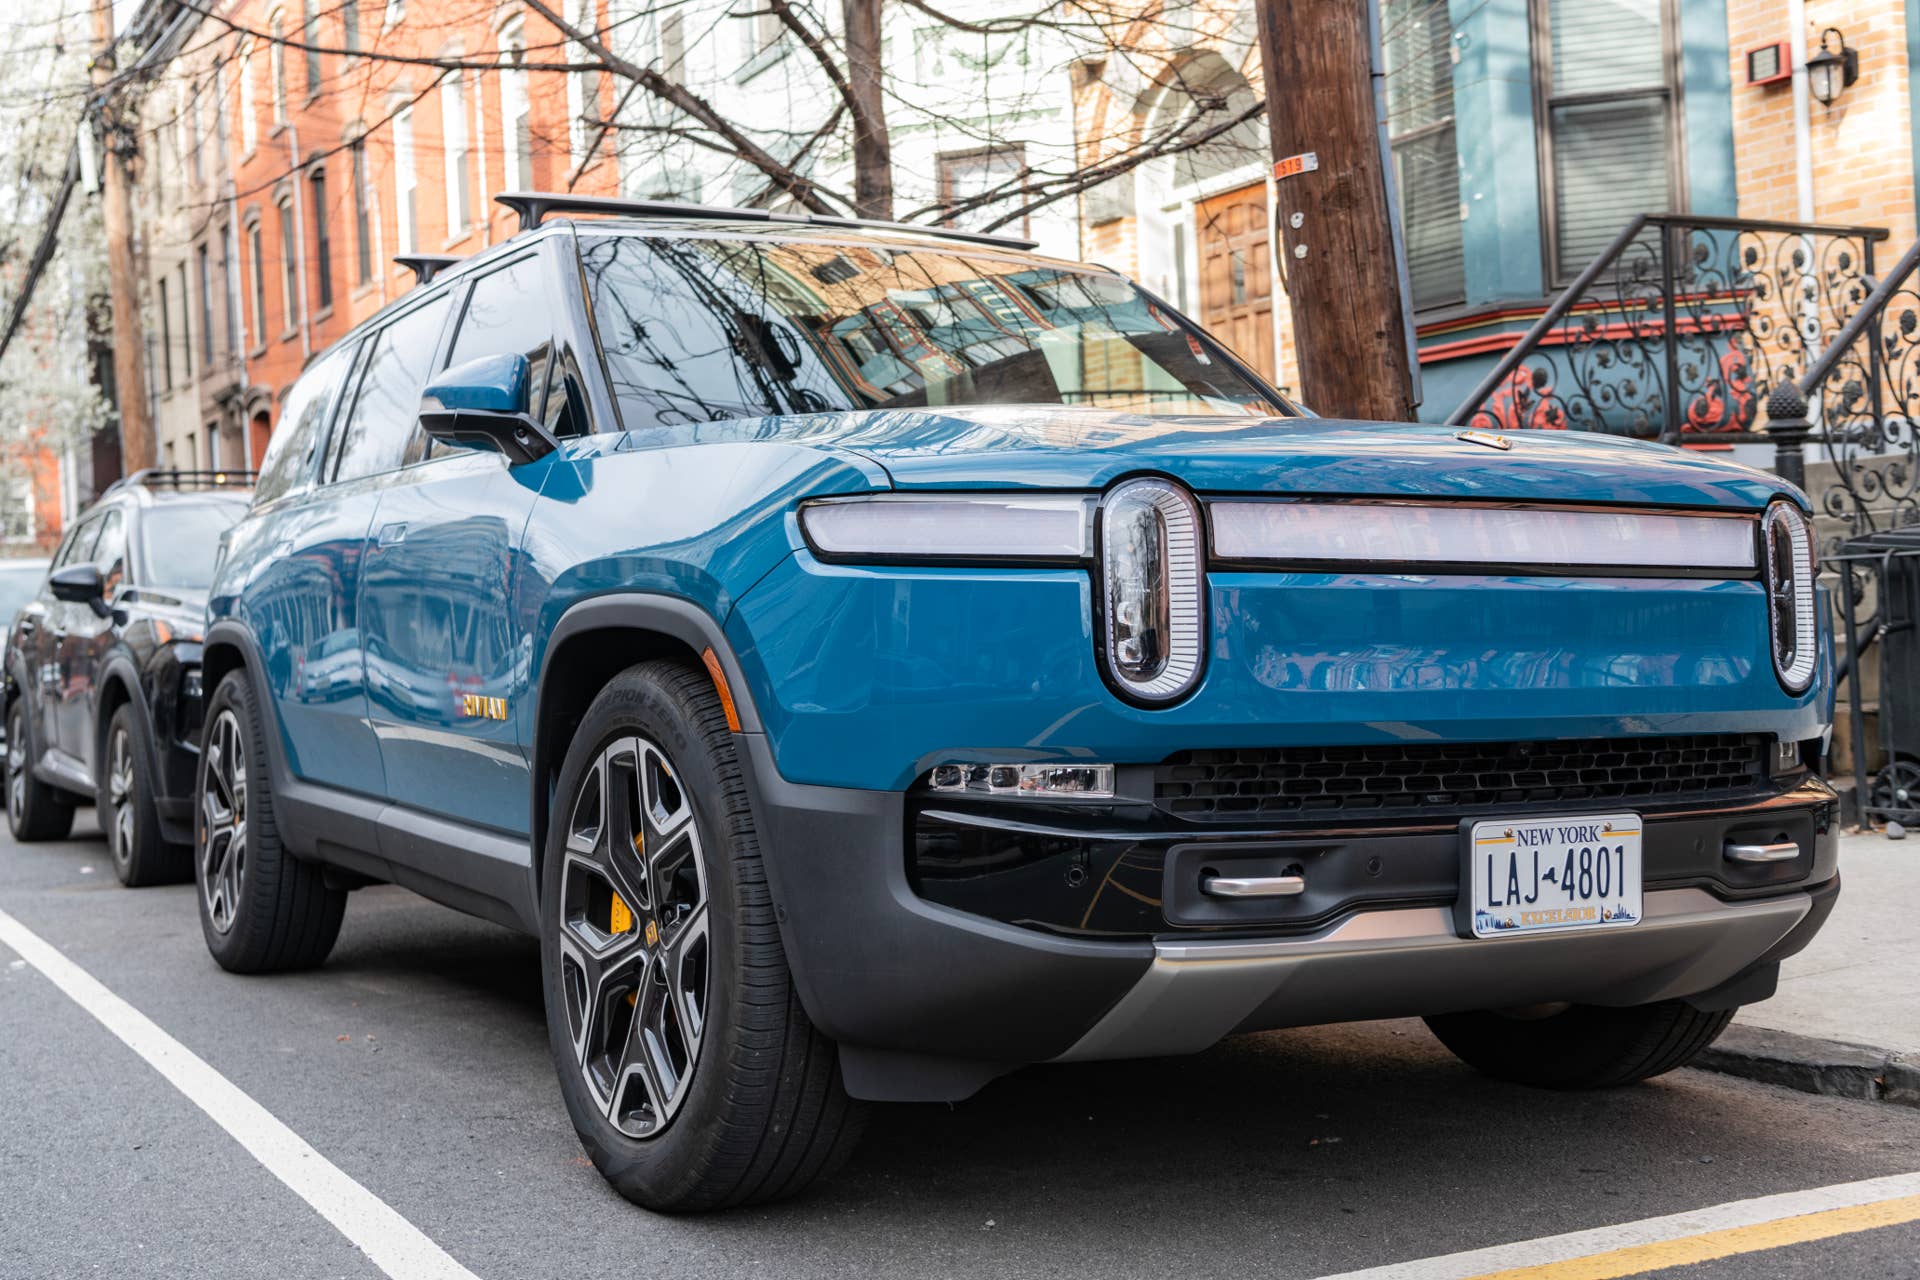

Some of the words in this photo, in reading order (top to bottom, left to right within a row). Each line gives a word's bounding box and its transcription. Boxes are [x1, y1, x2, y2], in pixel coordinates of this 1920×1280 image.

[1517, 828, 1555, 847] NEW
[1559, 825, 1601, 844] YORK
[1487, 850, 1539, 907] LAJ
[1561, 845, 1624, 901] 4801
[1520, 906, 1596, 926] EXCELSIOR
